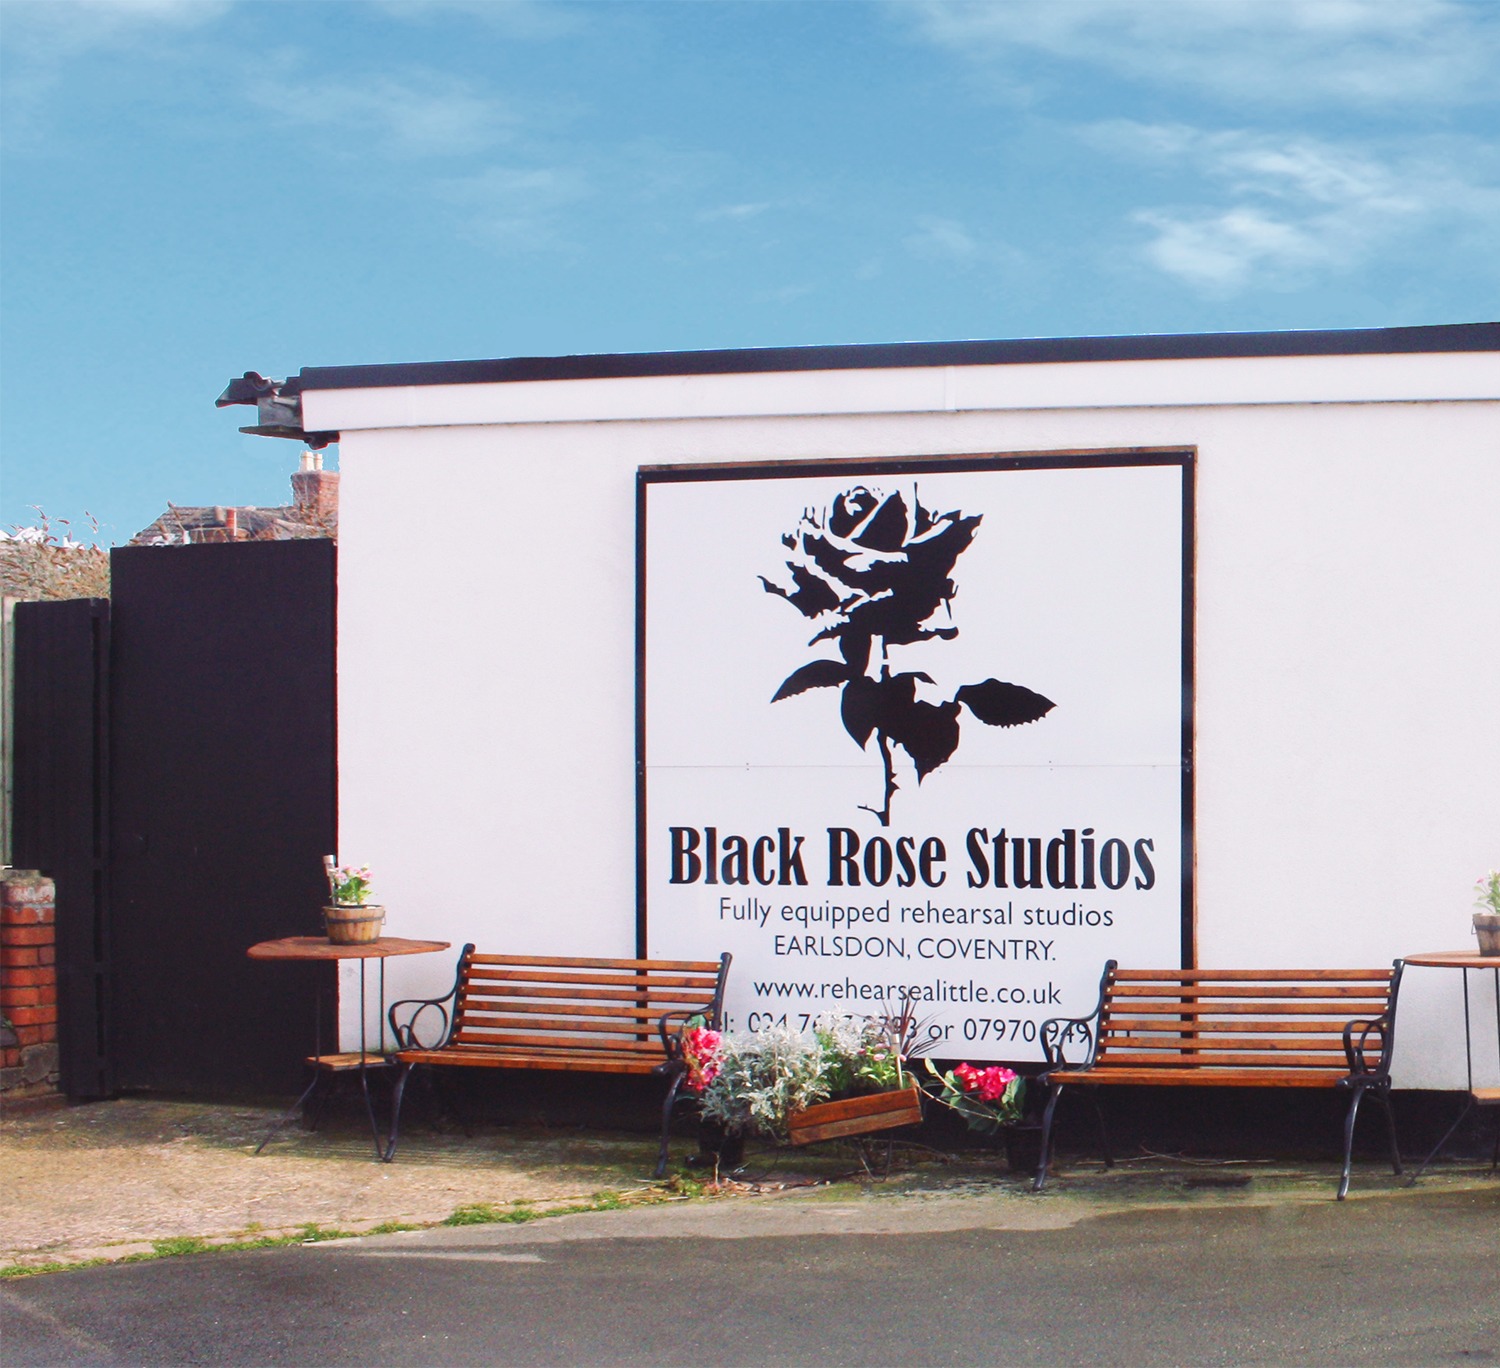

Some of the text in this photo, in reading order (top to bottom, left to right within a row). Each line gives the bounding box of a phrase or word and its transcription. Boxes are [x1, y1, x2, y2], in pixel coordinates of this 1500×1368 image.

[668, 826, 1156, 891] Black Rose Studios
[719, 897, 1115, 930] Fully equipped rehearsal studios
[774, 935, 1056, 961] EARLSDON, COVENTRY.
[753, 976, 1062, 1005] www.rehearsealittle.co.uk
[928, 1024, 954, 1041] or
[963, 1018, 1036, 1042] 07970
